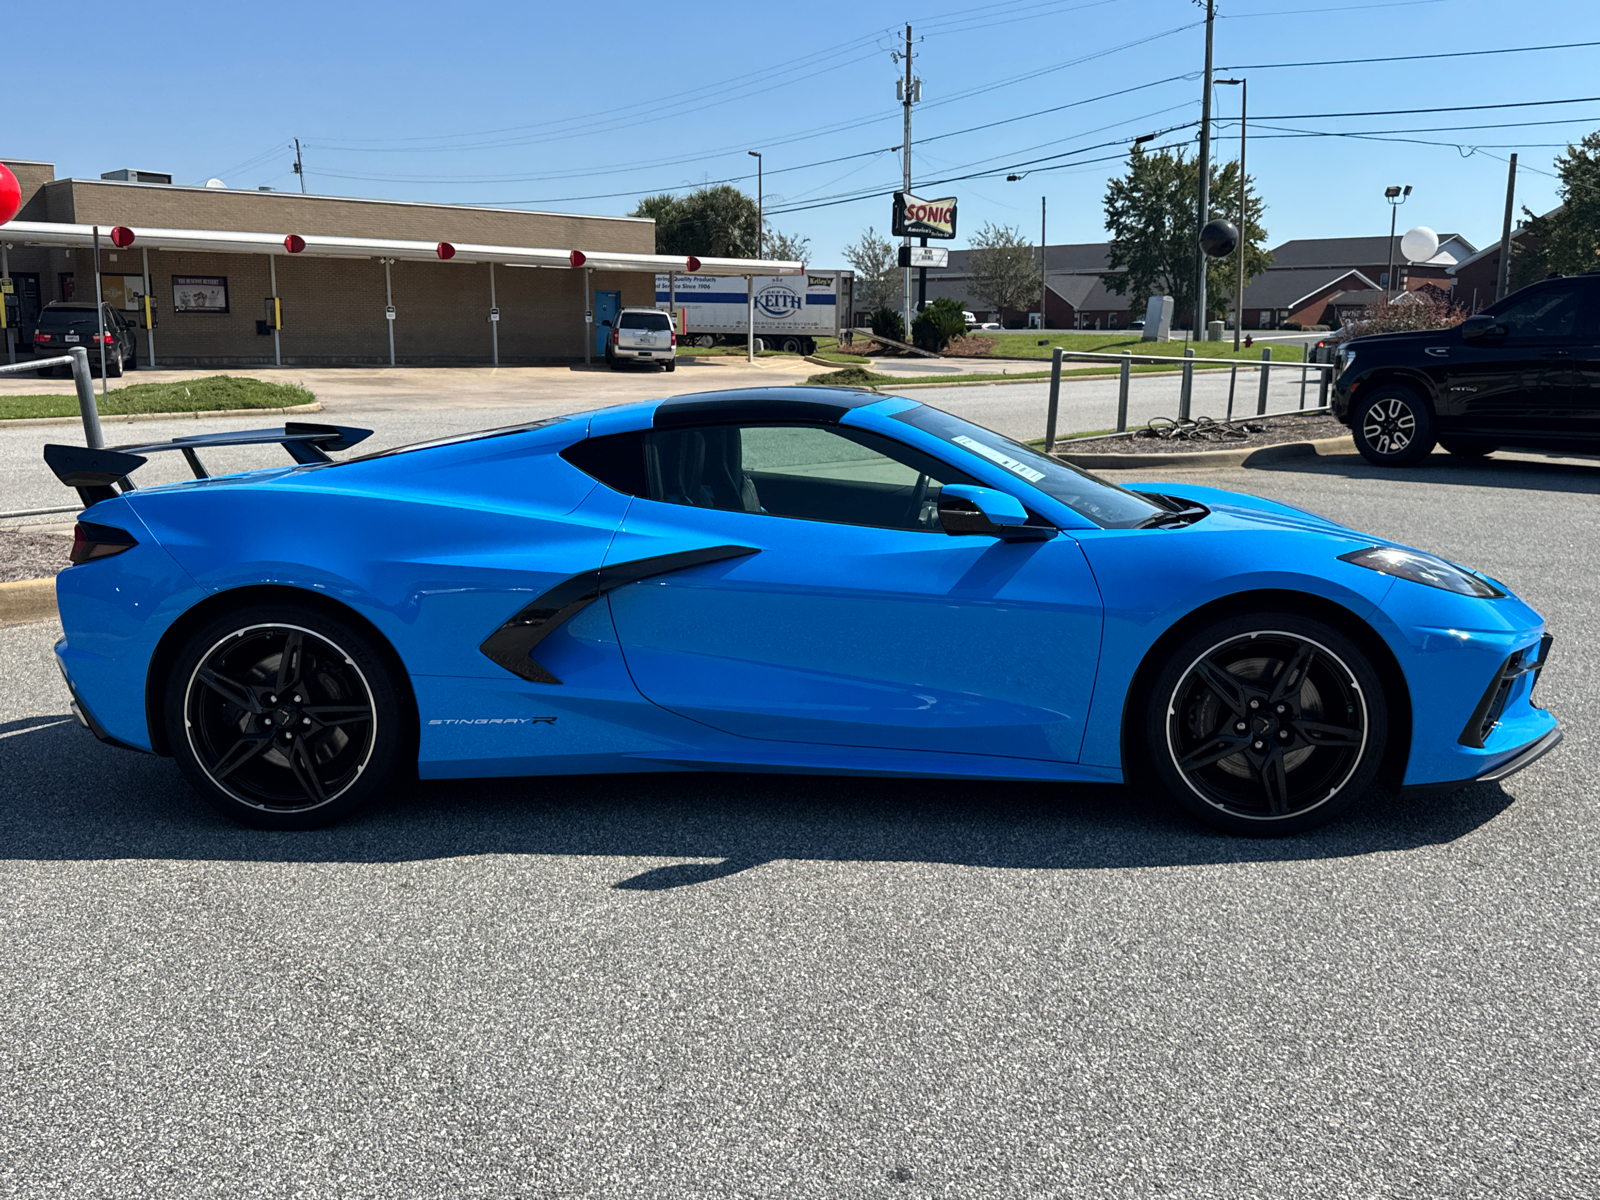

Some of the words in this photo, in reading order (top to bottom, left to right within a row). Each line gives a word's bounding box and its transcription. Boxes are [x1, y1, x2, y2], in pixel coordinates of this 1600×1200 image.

[906, 204, 952, 223] SONIC
[753, 294, 803, 311] KEITH
[319, 621, 371, 667] MICHELIN
